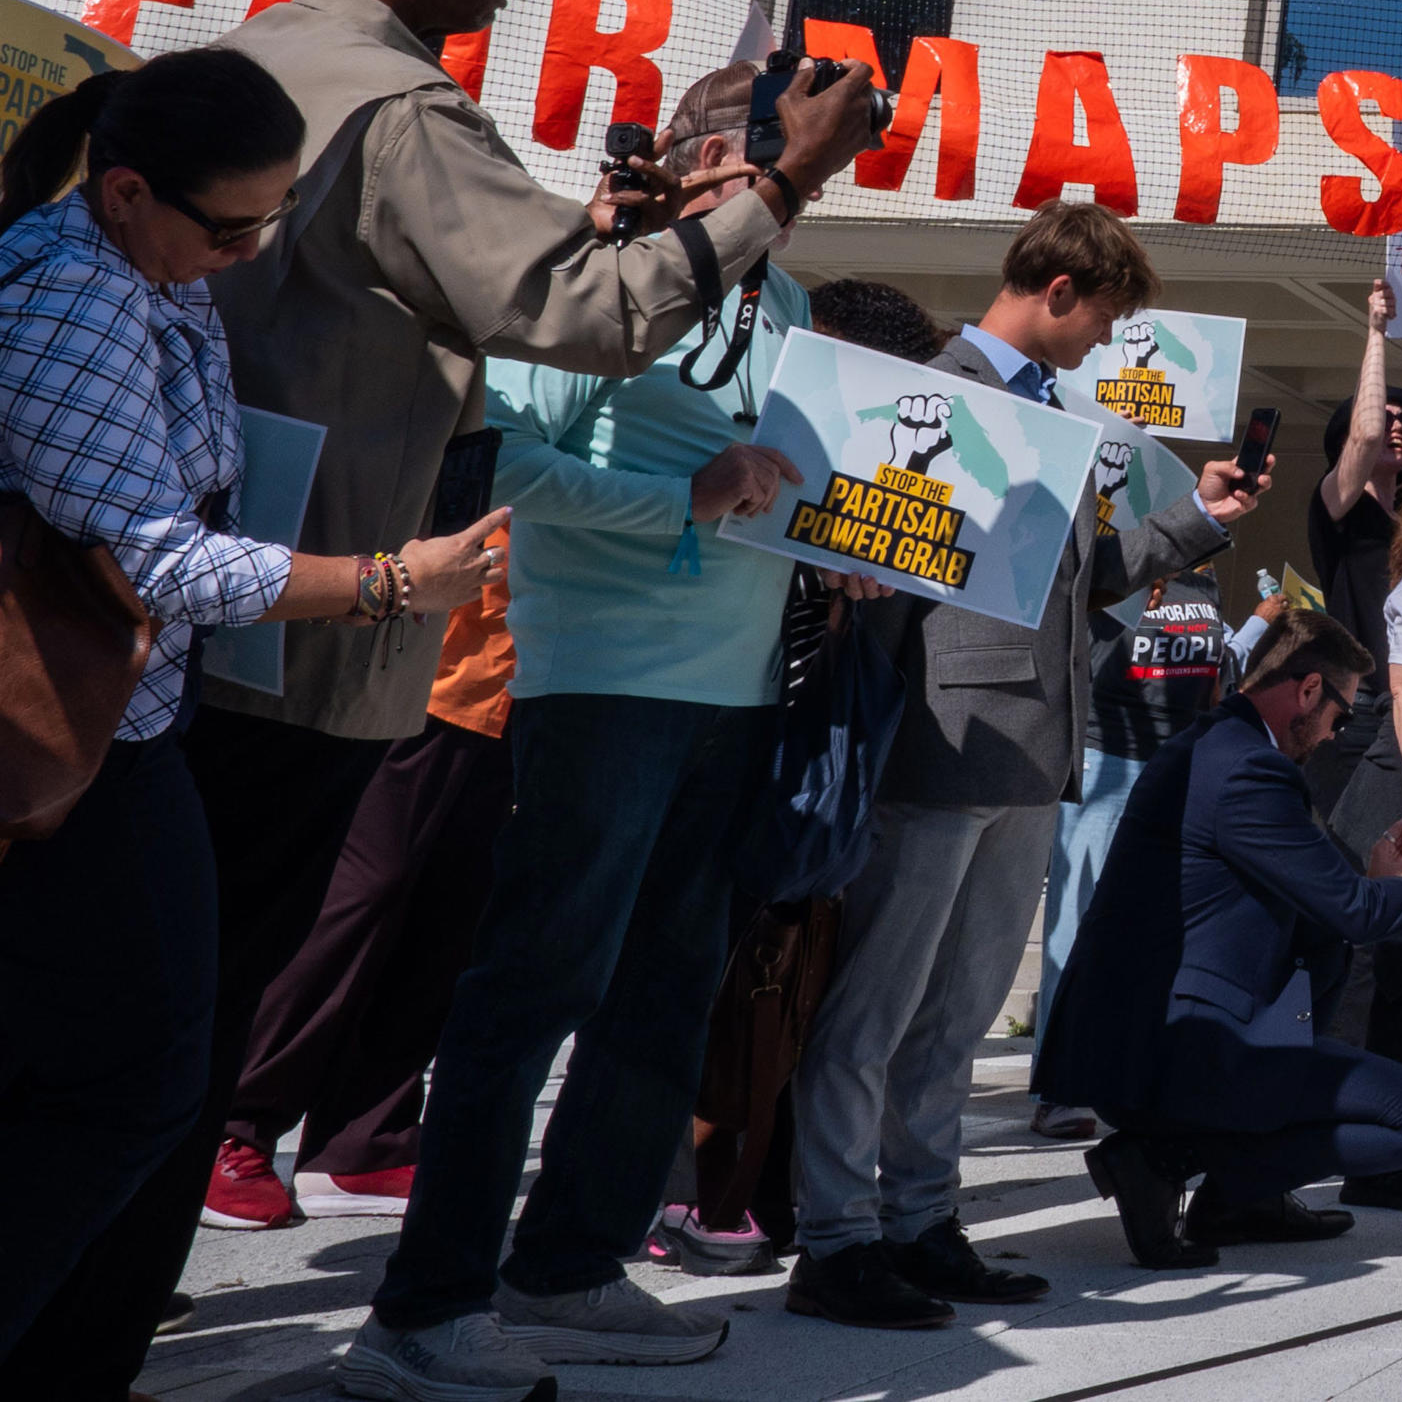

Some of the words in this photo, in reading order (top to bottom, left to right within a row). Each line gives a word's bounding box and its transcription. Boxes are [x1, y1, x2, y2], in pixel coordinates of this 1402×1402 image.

[0, 43, 39, 74] STOP
[41, 58, 68, 87] THE
[1097, 381, 1173, 405] PARTISAN
[1122, 369, 1143, 380] STOP
[1146, 370, 1163, 381] THE
[1139, 405, 1182, 427] GRAB
[878, 467, 919, 491] STOP
[920, 478, 949, 503] THE
[826, 476, 960, 546] PARTISAN
[792, 507, 890, 566] POWER
[895, 536, 969, 586] GRAB
